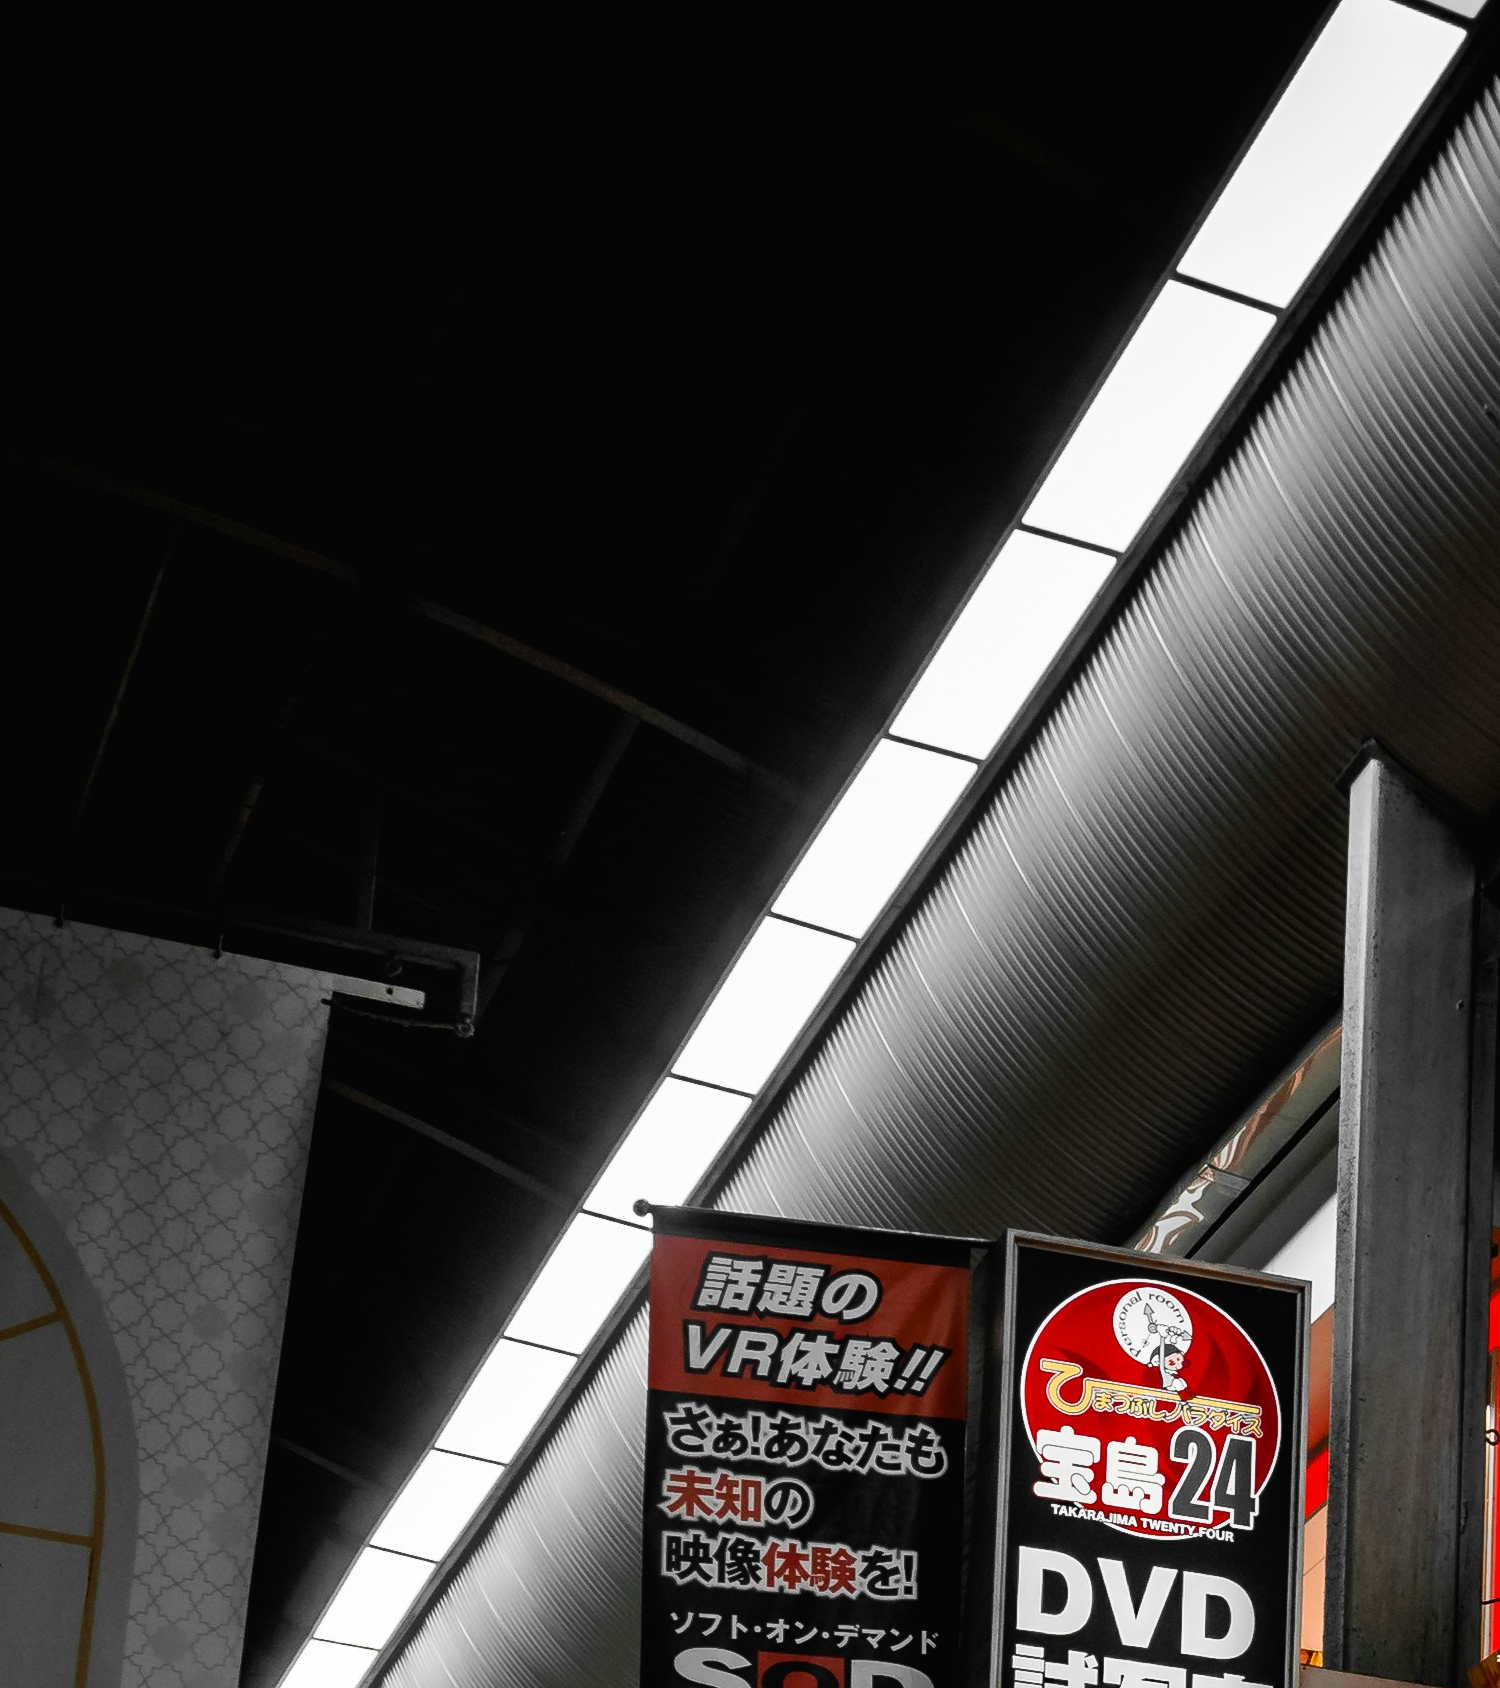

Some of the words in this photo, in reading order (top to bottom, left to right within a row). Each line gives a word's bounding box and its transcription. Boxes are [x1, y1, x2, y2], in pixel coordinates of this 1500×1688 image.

[697, 1254, 880, 1324] 話題の
[682, 1322, 946, 1401] VR体験!!
[665, 1402, 949, 1480] さぁ!あなたも
[1032, 1425, 1257, 1529] 宝島24
[658, 1470, 814, 1528] 未知の
[1050, 1502, 1137, 1529] TAKARAJIMA
[1138, 1515, 1193, 1538] TWENTY
[1195, 1525, 1236, 1544] FOUR
[658, 1532, 919, 1600] 映像体験を!
[1016, 1548, 1257, 1663] DVD
